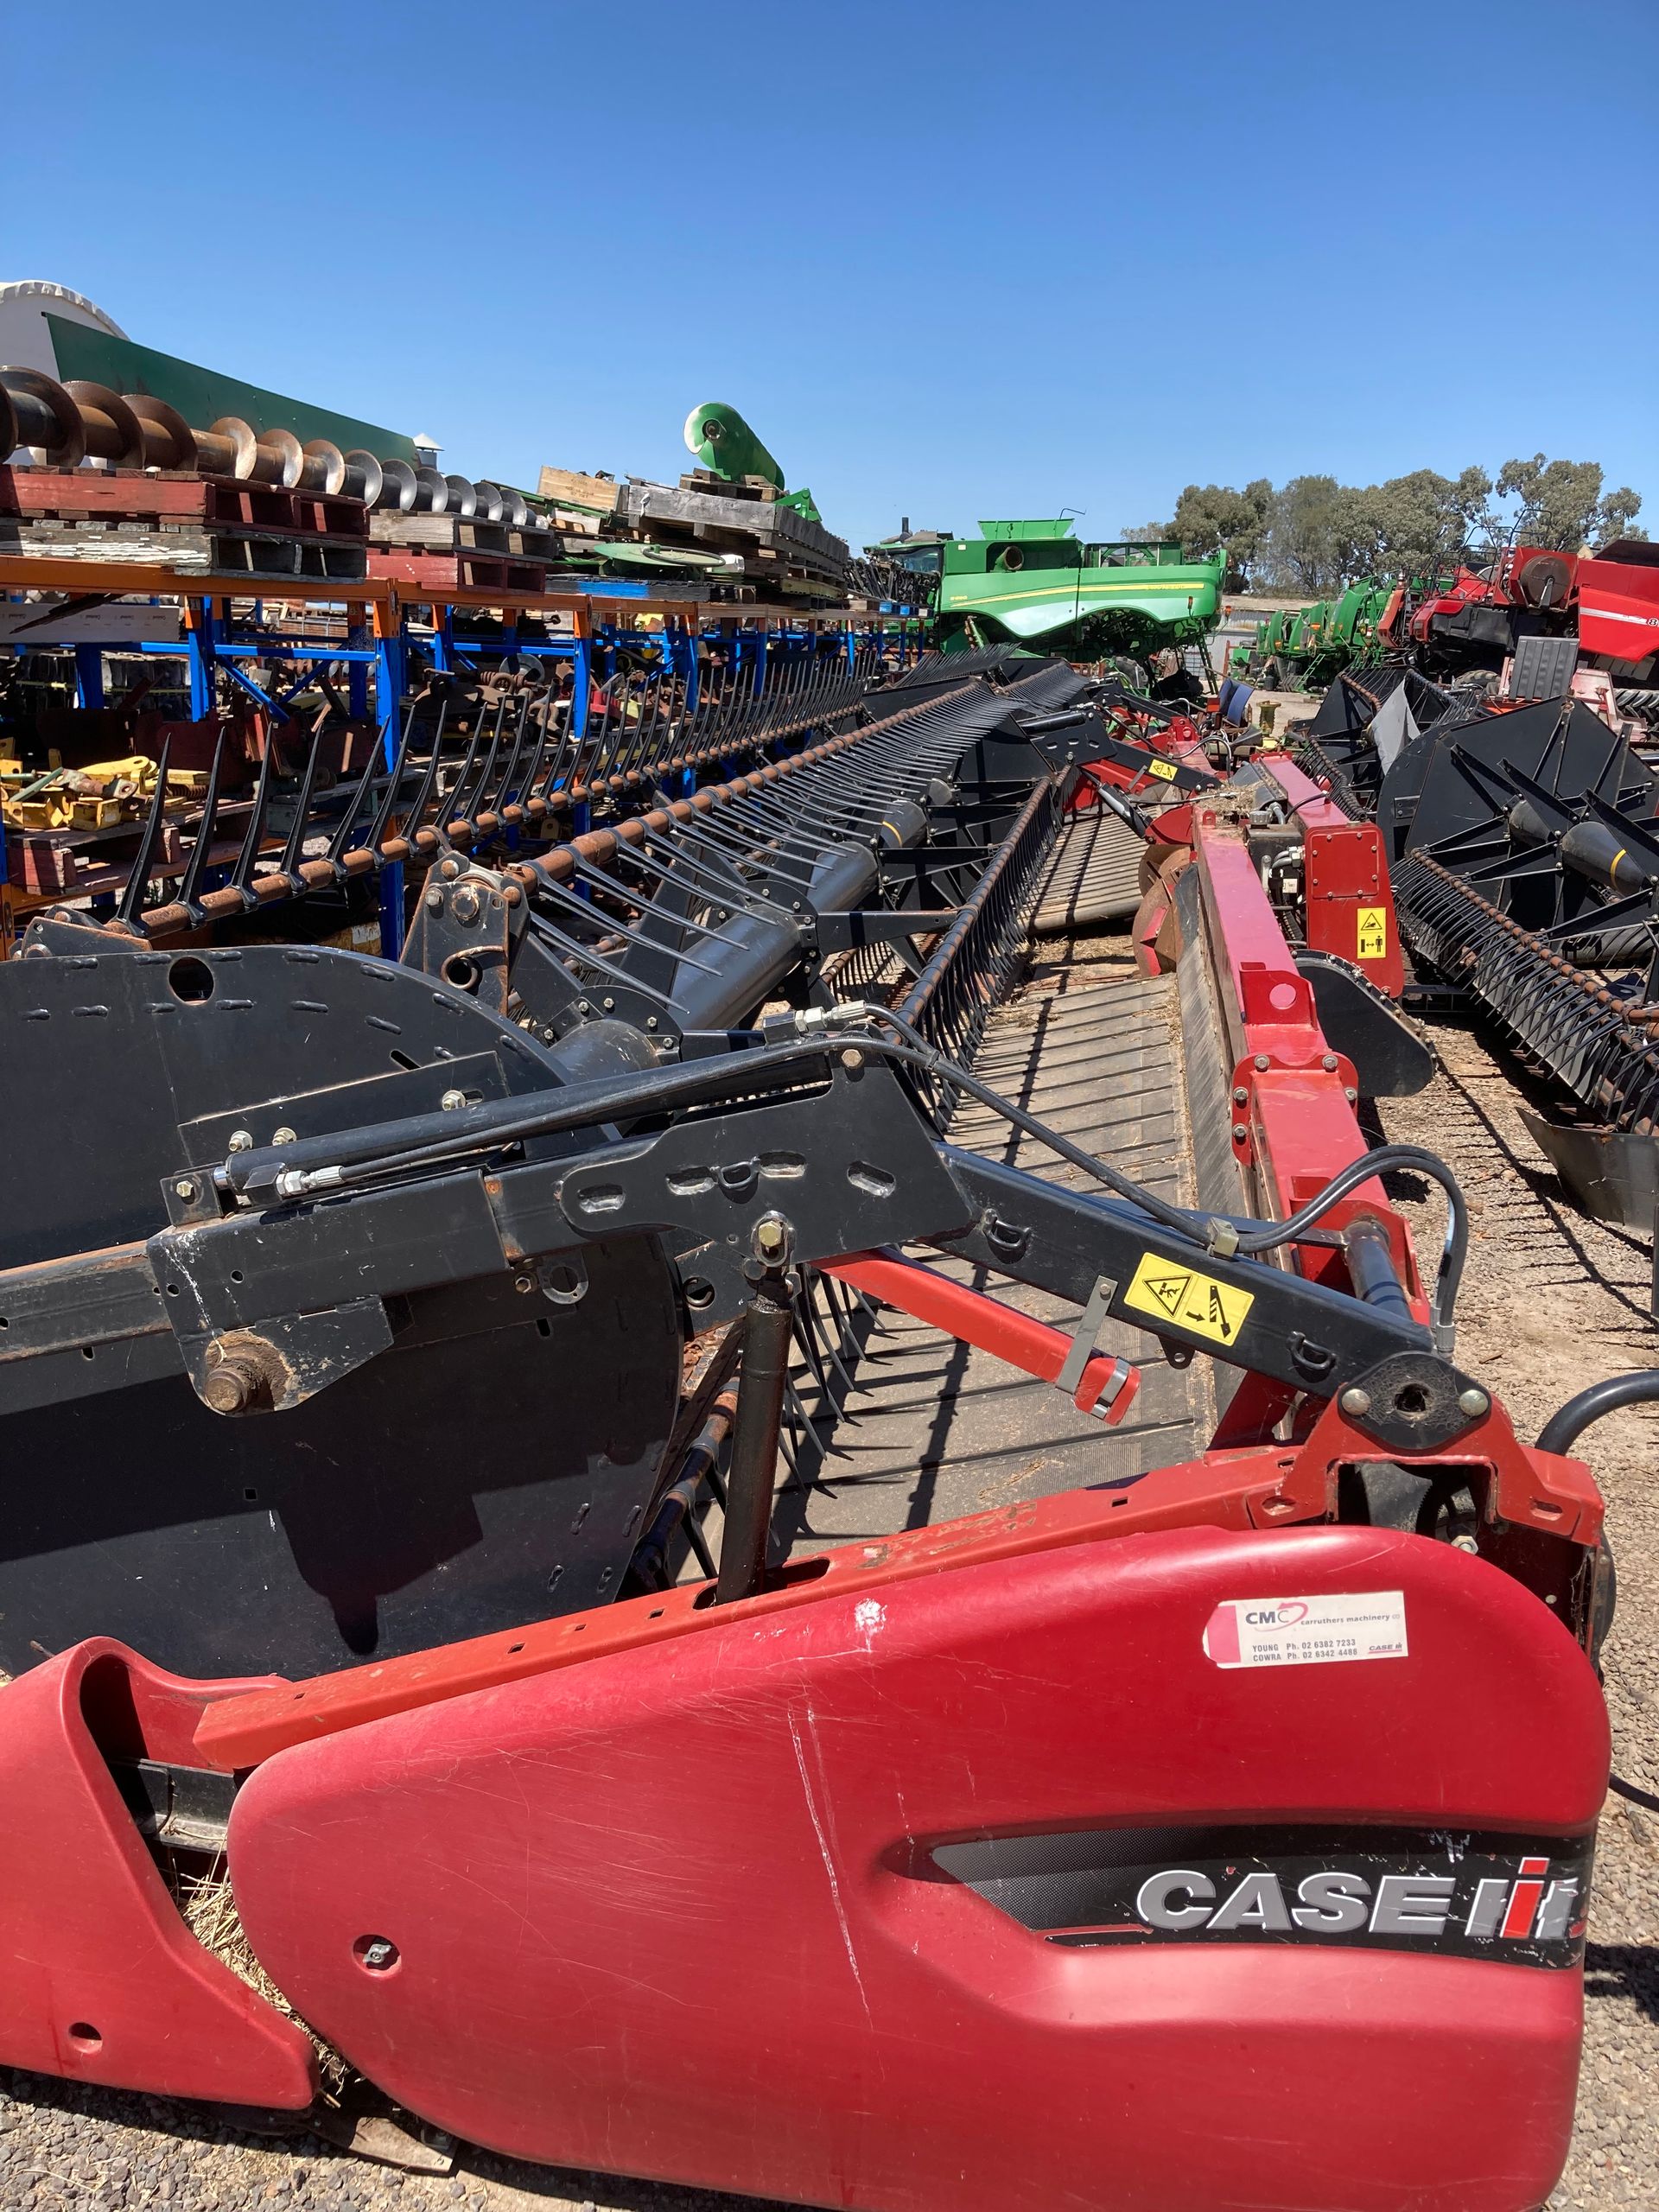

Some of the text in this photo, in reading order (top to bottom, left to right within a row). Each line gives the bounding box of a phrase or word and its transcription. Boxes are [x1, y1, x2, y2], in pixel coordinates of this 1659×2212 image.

[1245, 1610, 1290, 1625] CMC
[1300, 1616, 1344, 1625] carruthers
[1346, 1612, 1390, 1623] machinery
[1252, 1643, 1279, 1653] YOUNG
[1313, 1640, 1334, 1649] 6382
[1336, 1638, 1356, 1648] 7233
[1253, 1653, 1281, 1662] COWRA
[1136, 1869, 1457, 1936] CASE
